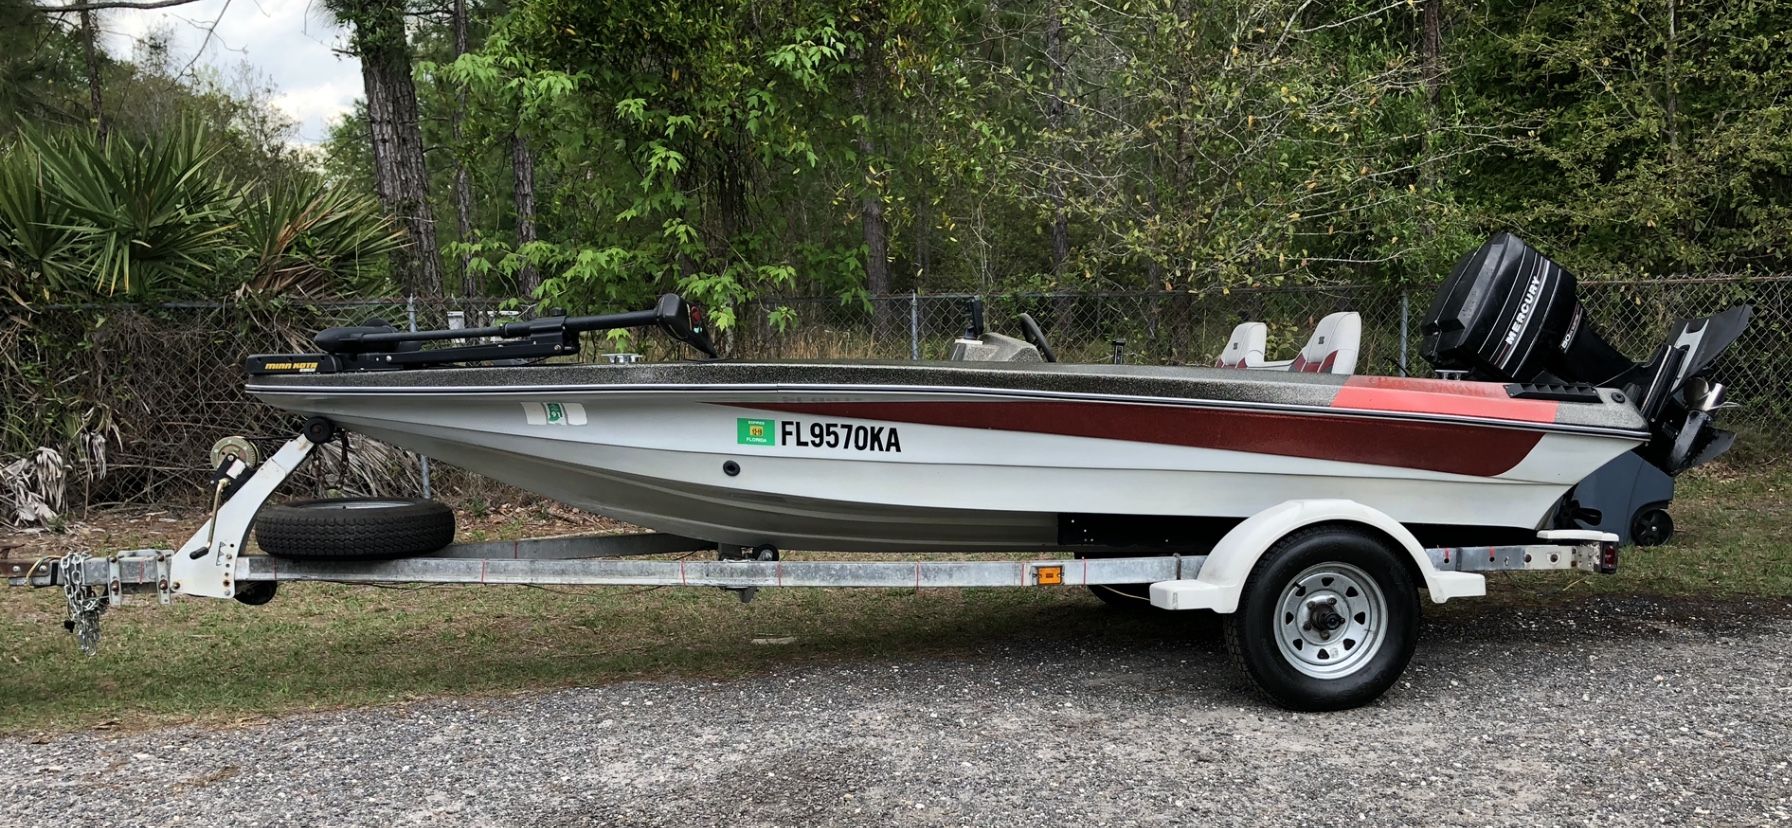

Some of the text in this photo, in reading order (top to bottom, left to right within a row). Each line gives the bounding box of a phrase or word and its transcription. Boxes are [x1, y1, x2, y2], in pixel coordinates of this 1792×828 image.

[1505, 275, 1541, 346] MERCURY
[293, 362, 319, 370] KOTA
[781, 420, 902, 453] FL9570KA
